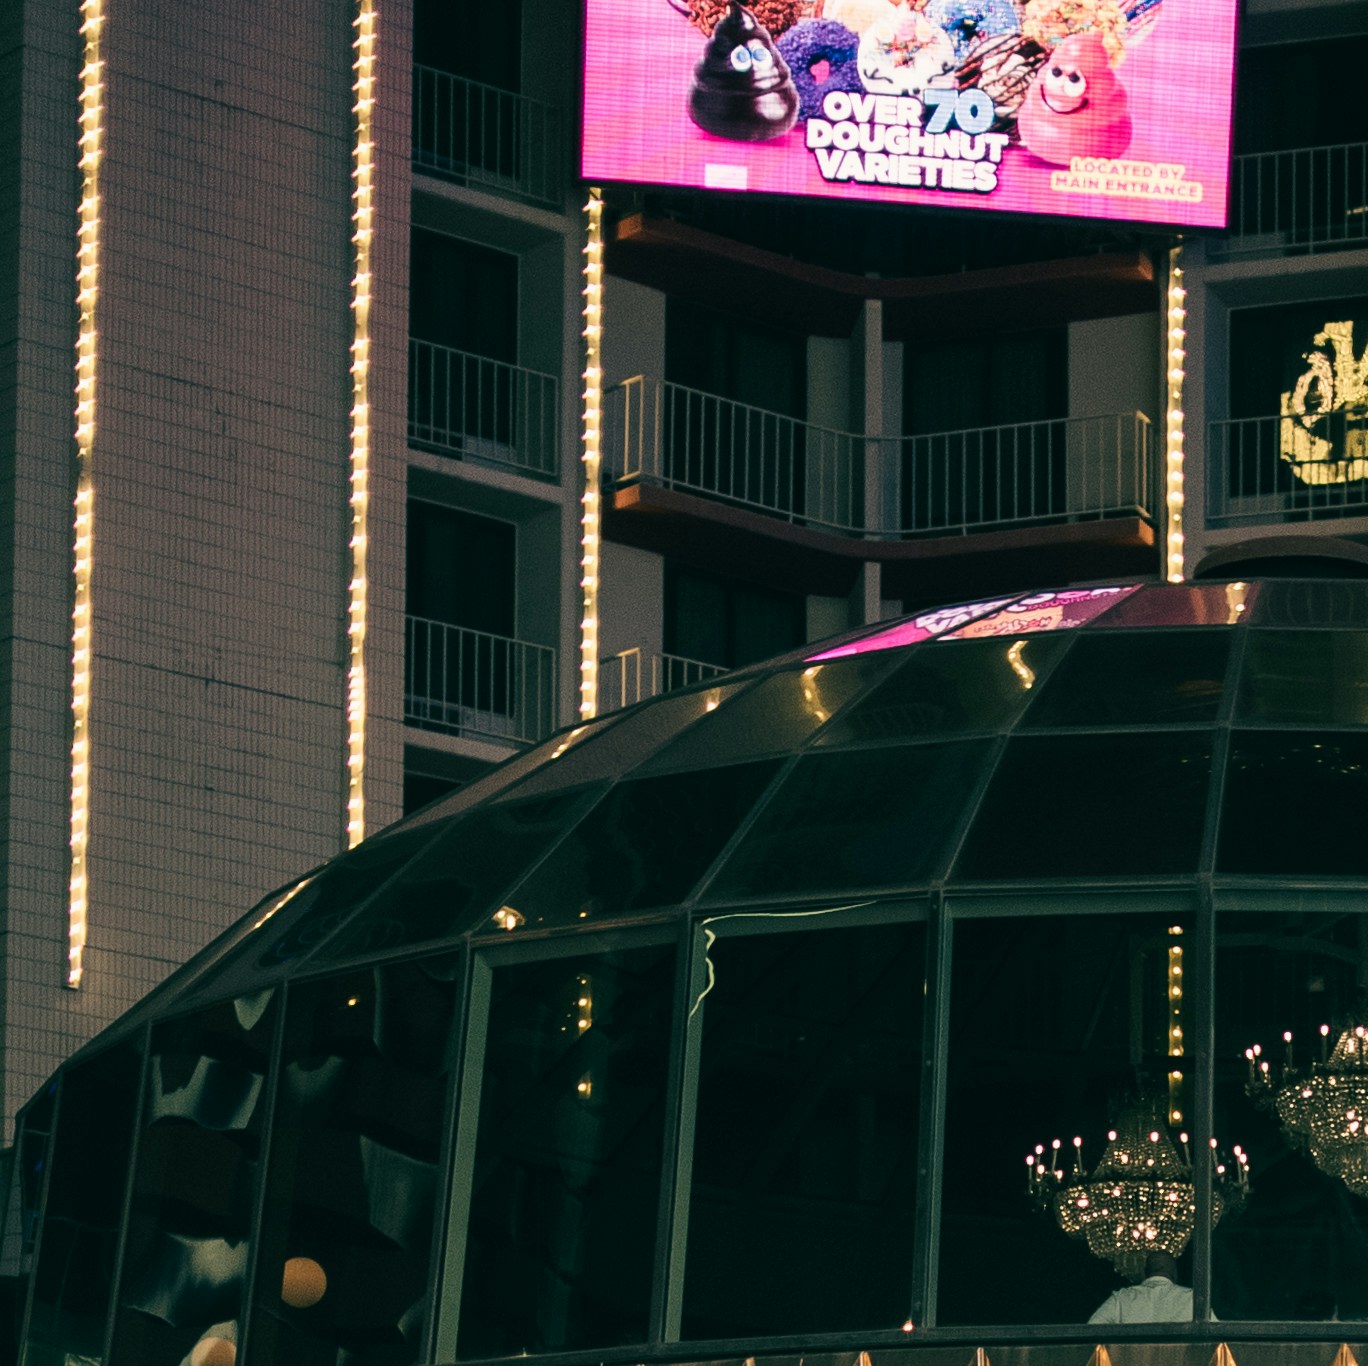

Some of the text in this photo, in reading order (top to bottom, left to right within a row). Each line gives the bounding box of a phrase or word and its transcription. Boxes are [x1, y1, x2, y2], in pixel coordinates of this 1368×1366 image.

[823, 88, 995, 134] OVER 70
[806, 118, 1010, 163] DOUGHNUT
[814, 148, 998, 192] VARIETIES
[1055, 176, 1199, 198] MAIN ENTRANCE
[1074, 161, 1182, 180] LOCATED BY
